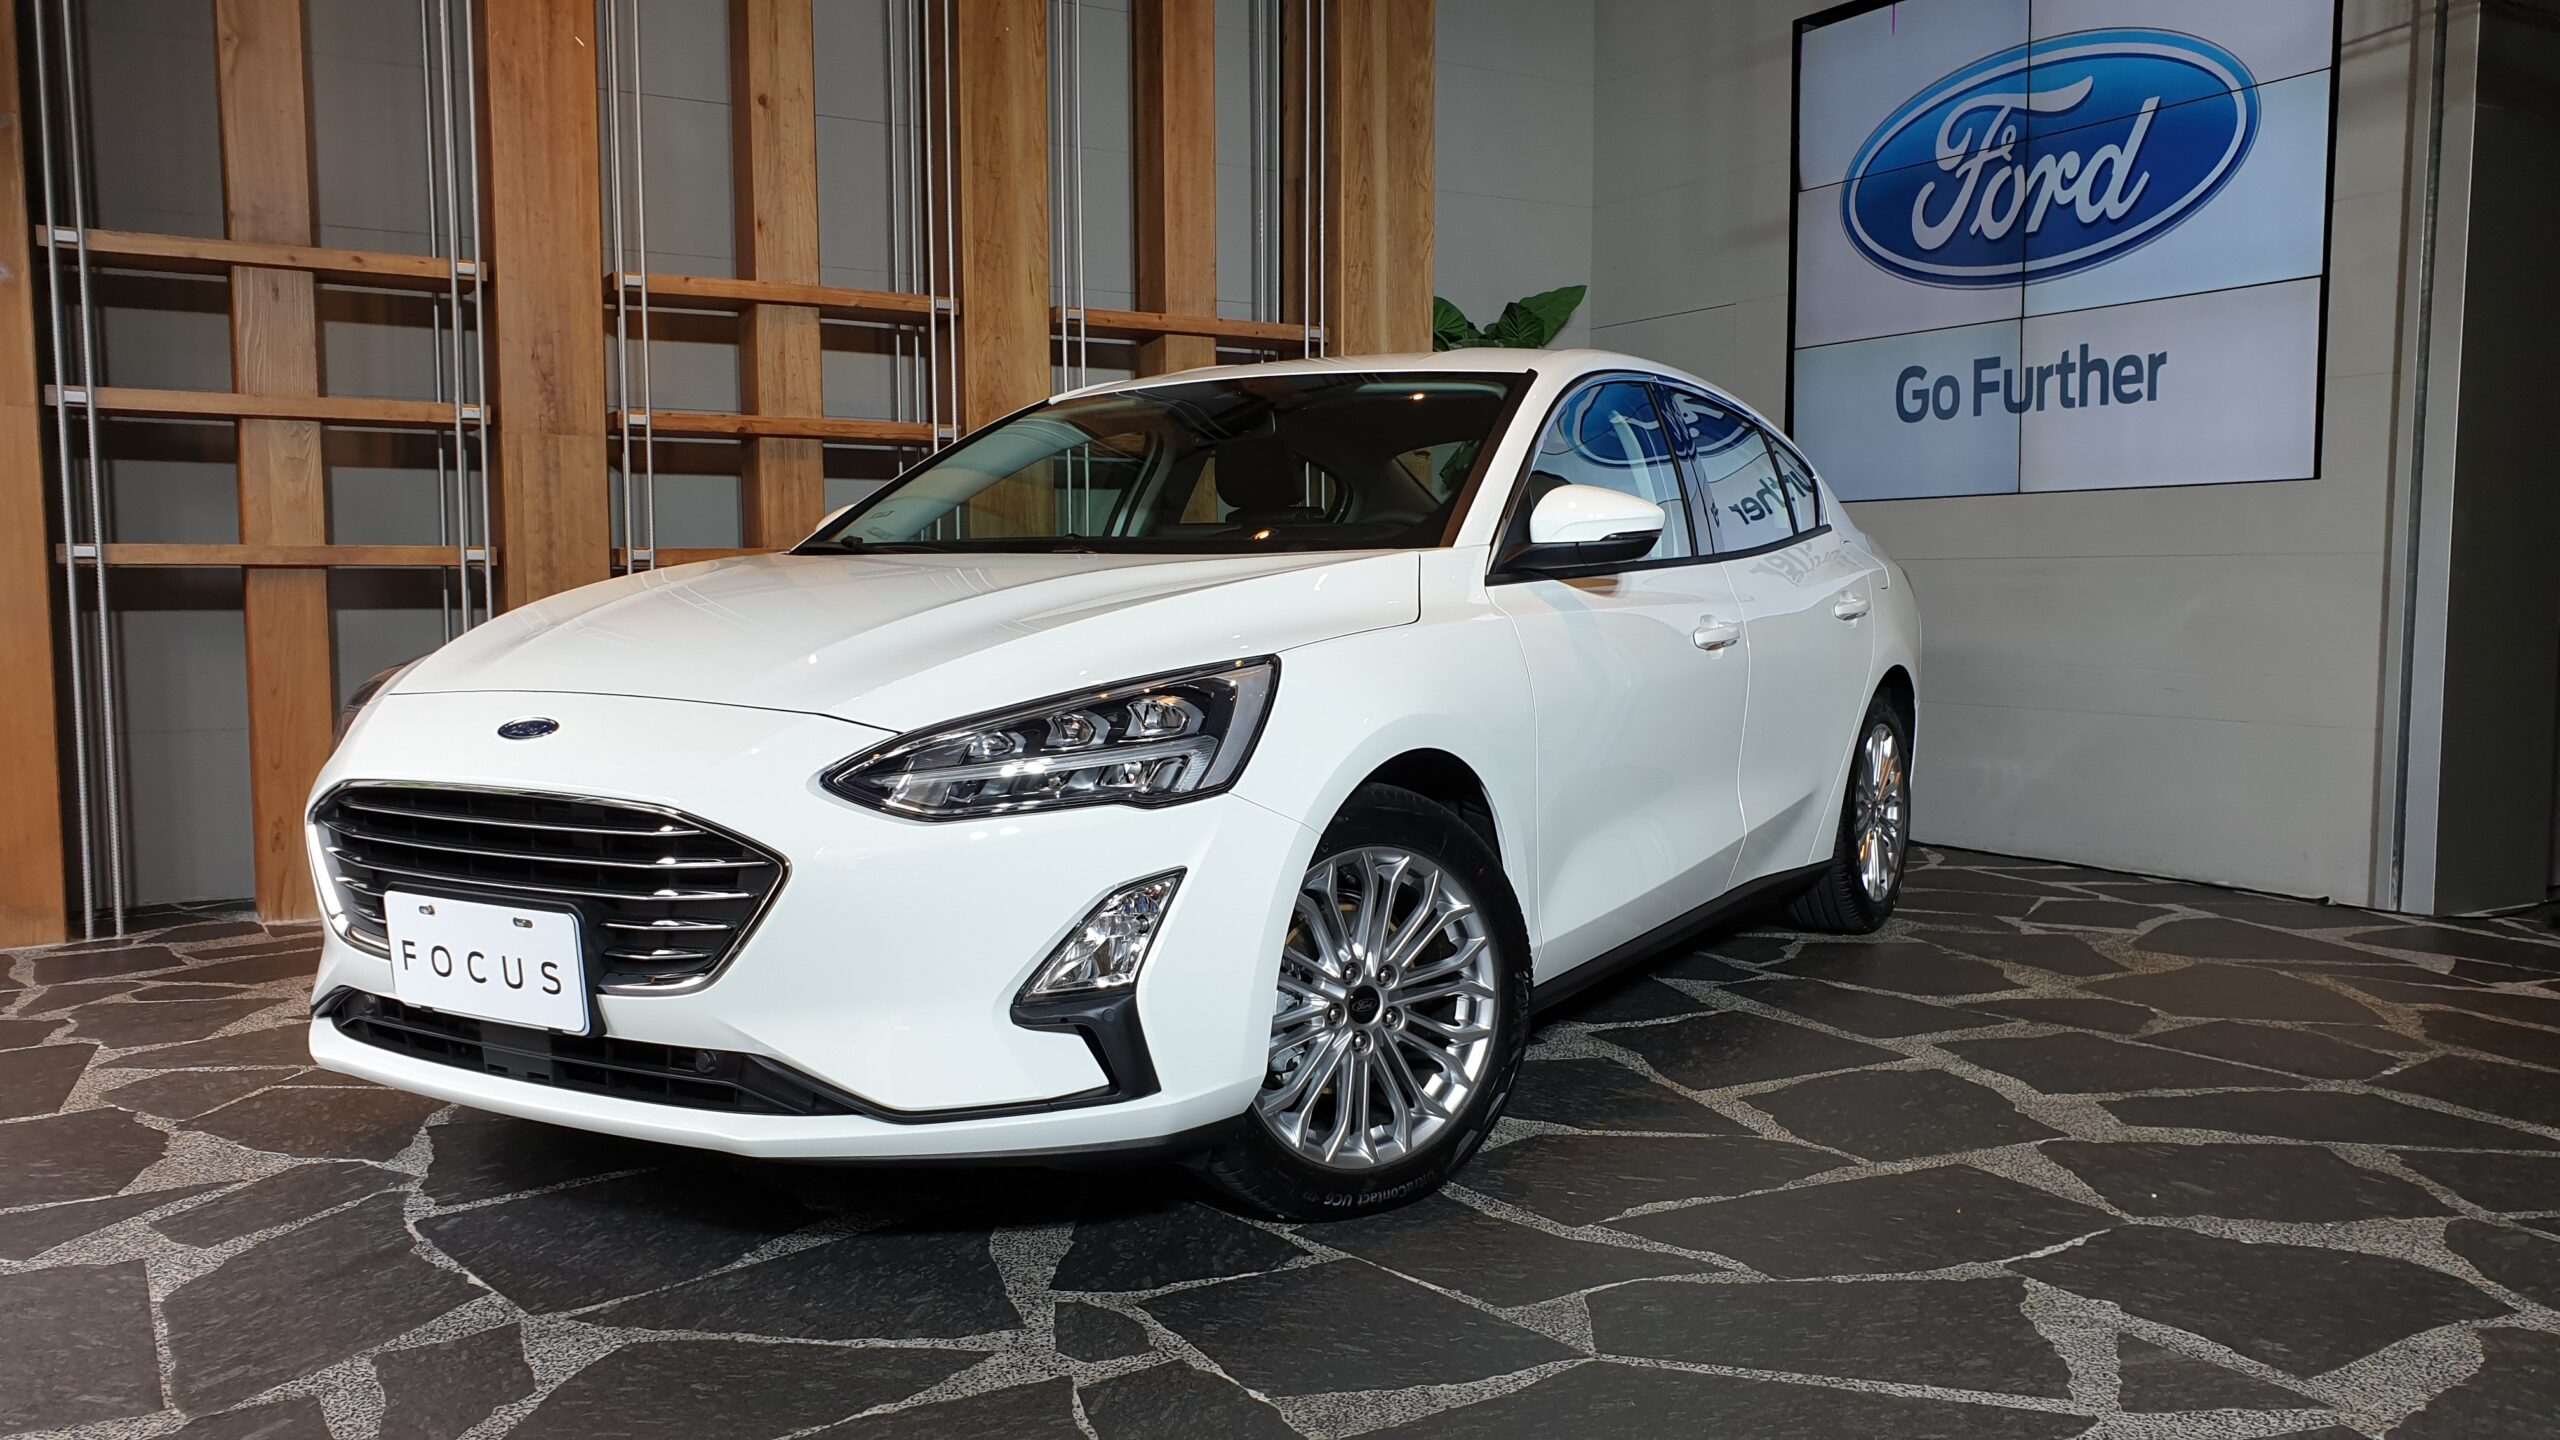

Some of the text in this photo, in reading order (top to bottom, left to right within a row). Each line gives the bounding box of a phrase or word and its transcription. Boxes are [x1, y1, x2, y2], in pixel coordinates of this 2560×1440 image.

[1911, 75, 2160, 250] Ford
[1895, 343, 2168, 423] Go Further
[401, 939, 562, 995] FOCUS
[1323, 1192, 1352, 1207] UC6
